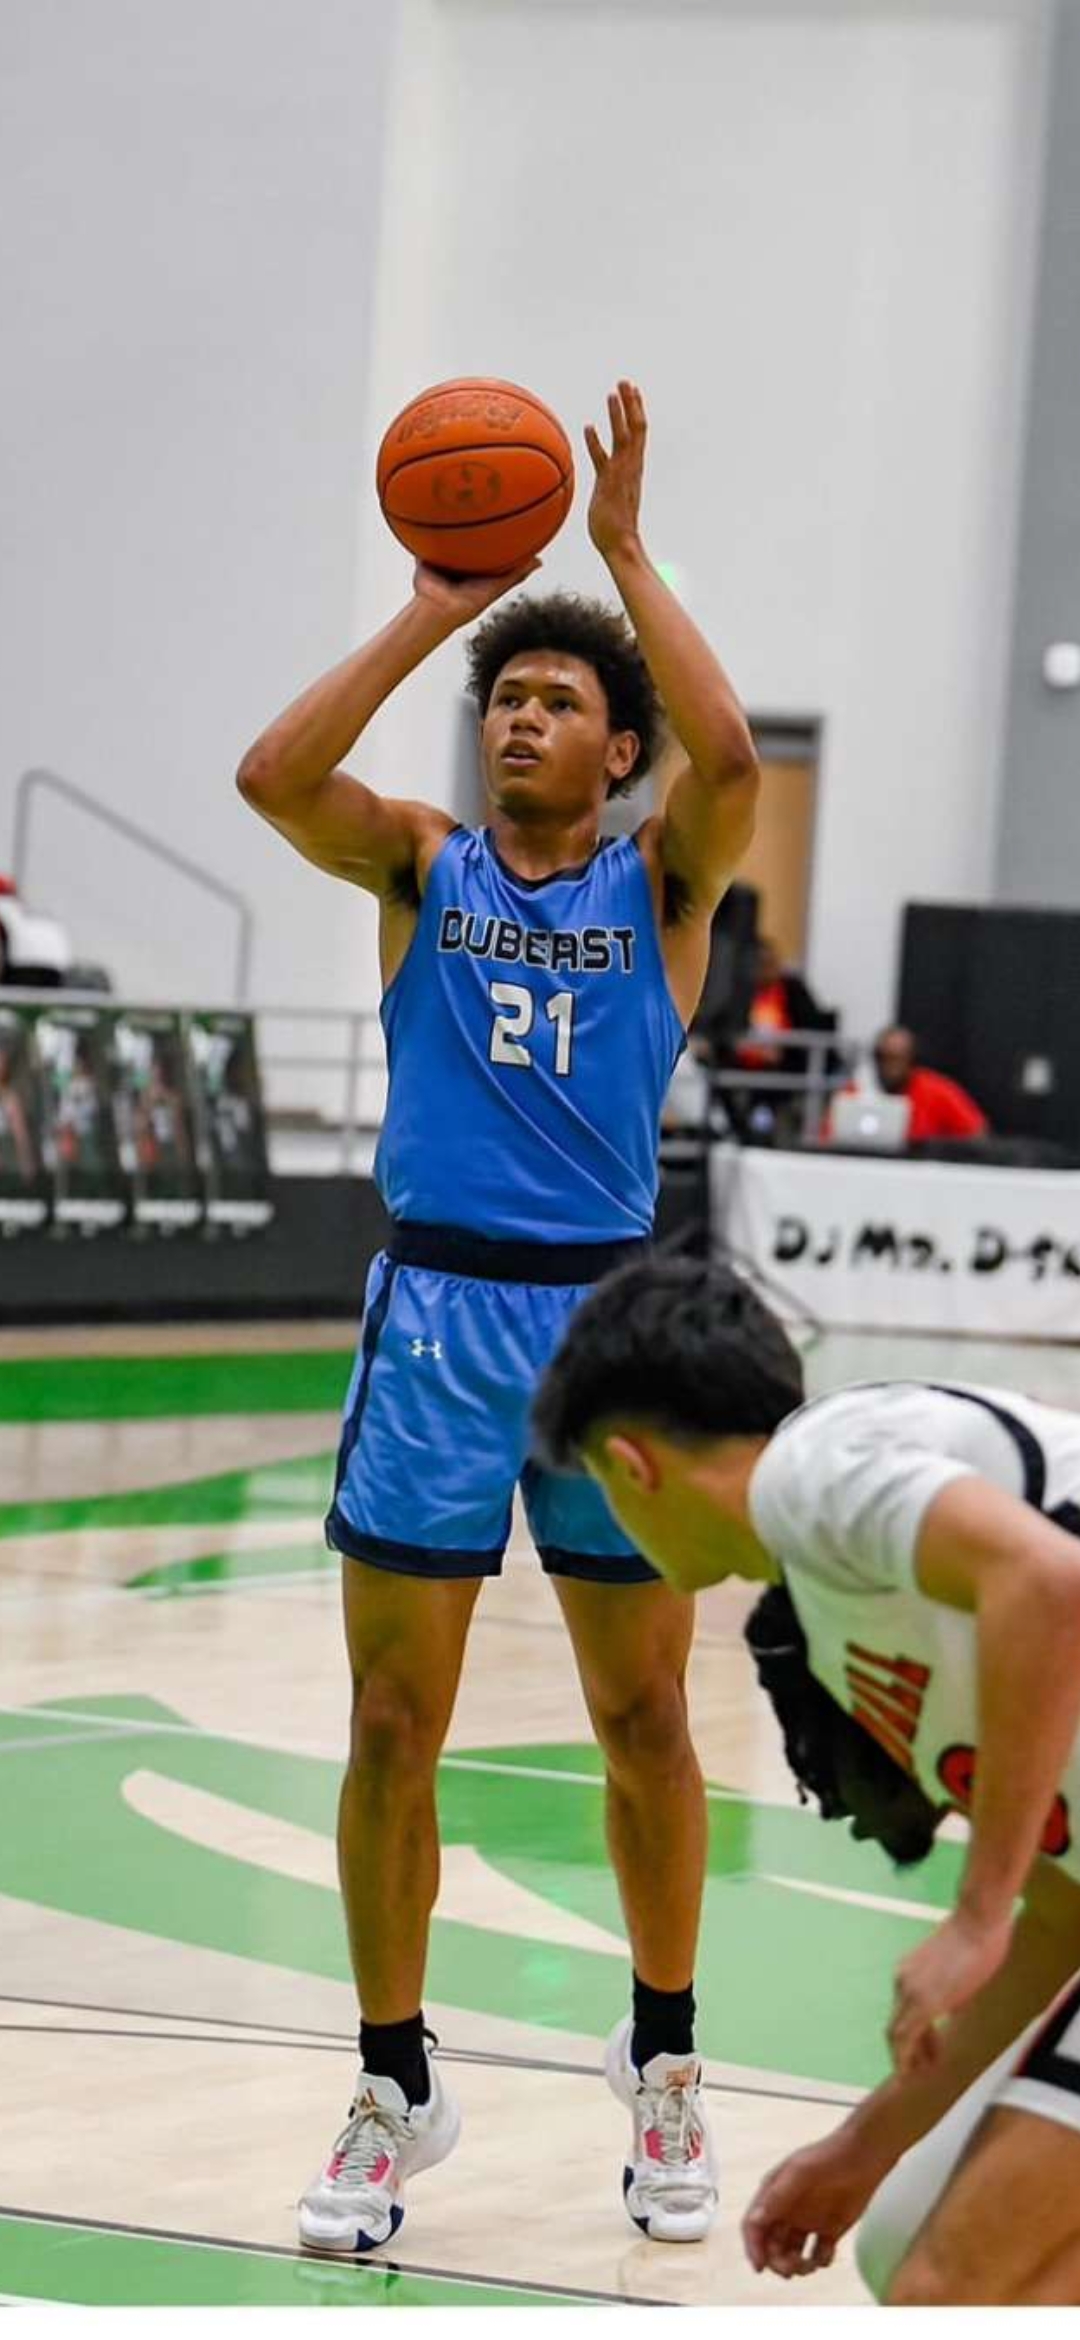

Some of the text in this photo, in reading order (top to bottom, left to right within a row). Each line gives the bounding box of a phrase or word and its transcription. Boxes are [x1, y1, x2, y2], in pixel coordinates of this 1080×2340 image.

[437, 906, 635, 974] DUBEAST
[488, 980, 574, 1077] 21
[773, 1216, 841, 1264] DJ
